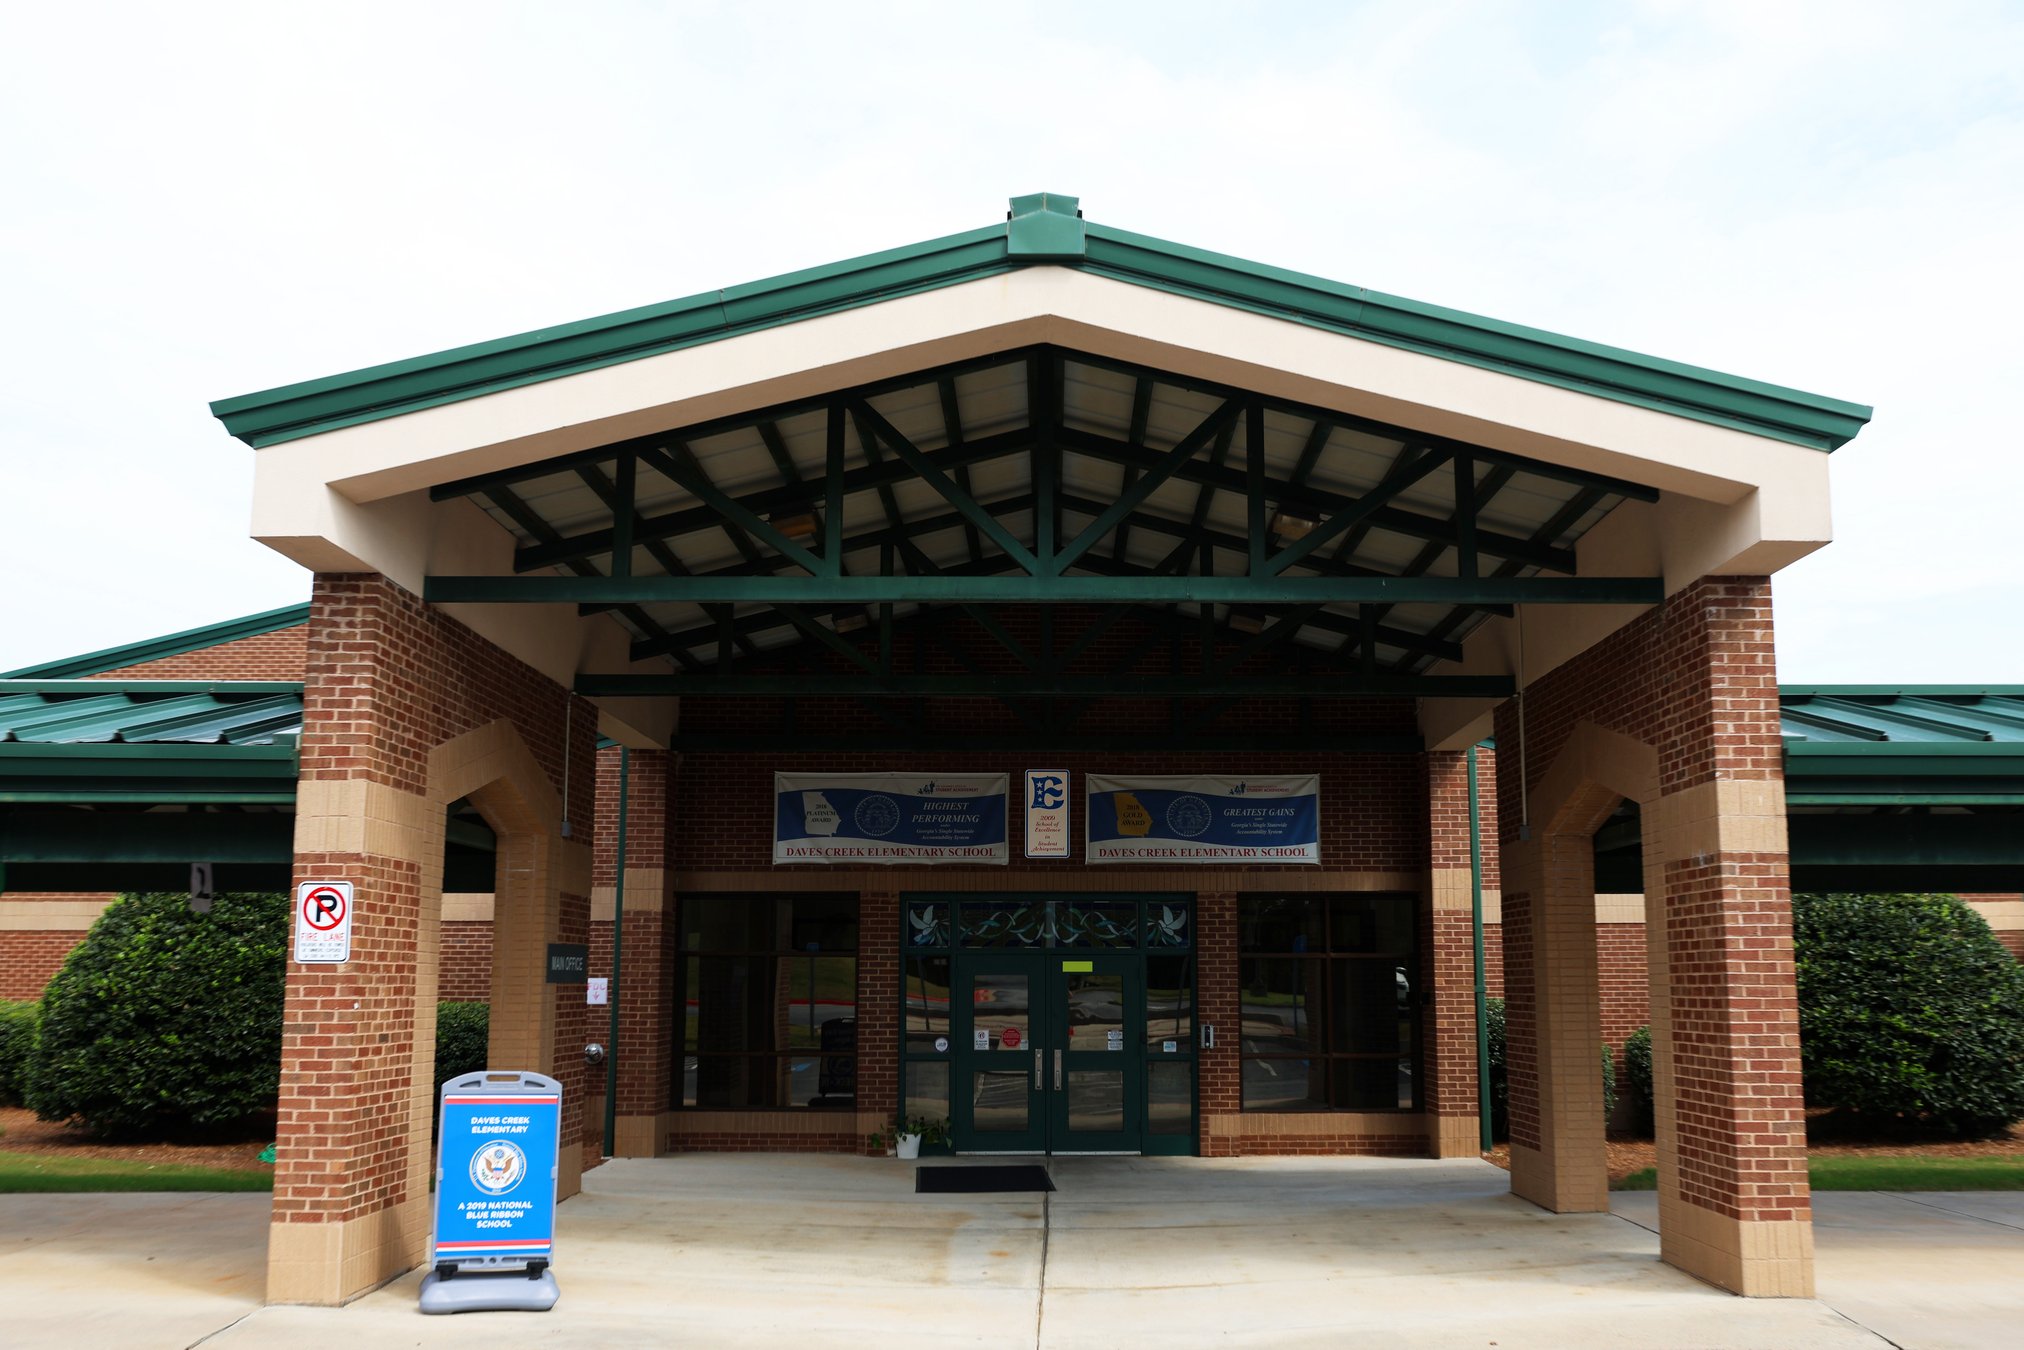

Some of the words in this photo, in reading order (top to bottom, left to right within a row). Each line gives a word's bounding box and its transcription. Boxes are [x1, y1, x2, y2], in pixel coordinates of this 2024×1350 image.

[923, 802, 970, 810] HIGHEST
[1223, 808, 1267, 816] GREATEST
[1268, 808, 1296, 816] GAINS
[911, 814, 980, 823] PERFORMING
[786, 847, 823, 856] DAVES
[825, 847, 865, 856] CREEK
[868, 847, 947, 857] ELEMENTARY
[948, 848, 996, 857] SCHOOL
[1099, 848, 1135, 857] DAVES
[1138, 848, 1176, 857] CREEK
[1180, 848, 1258, 857] ELEMENTARY
[1260, 848, 1309, 857] SCHOOL
[301, 933, 318, 941] FIRE
[323, 933, 345, 941] LANE
[551, 956, 565, 970] MAIN
[565, 956, 583, 970] OFFICE
[501, 1116, 530, 1124] CREEK
[471, 1125, 529, 1134] ELEMENTARY
[457, 1202, 466, 1210] A
[466, 1202, 487, 1210] 2019
[488, 1201, 533, 1209] NATIONAL
[466, 1211, 489, 1219] BLUE
[490, 1211, 524, 1219] RIBBON
[476, 1220, 513, 1228] SCHOOL
